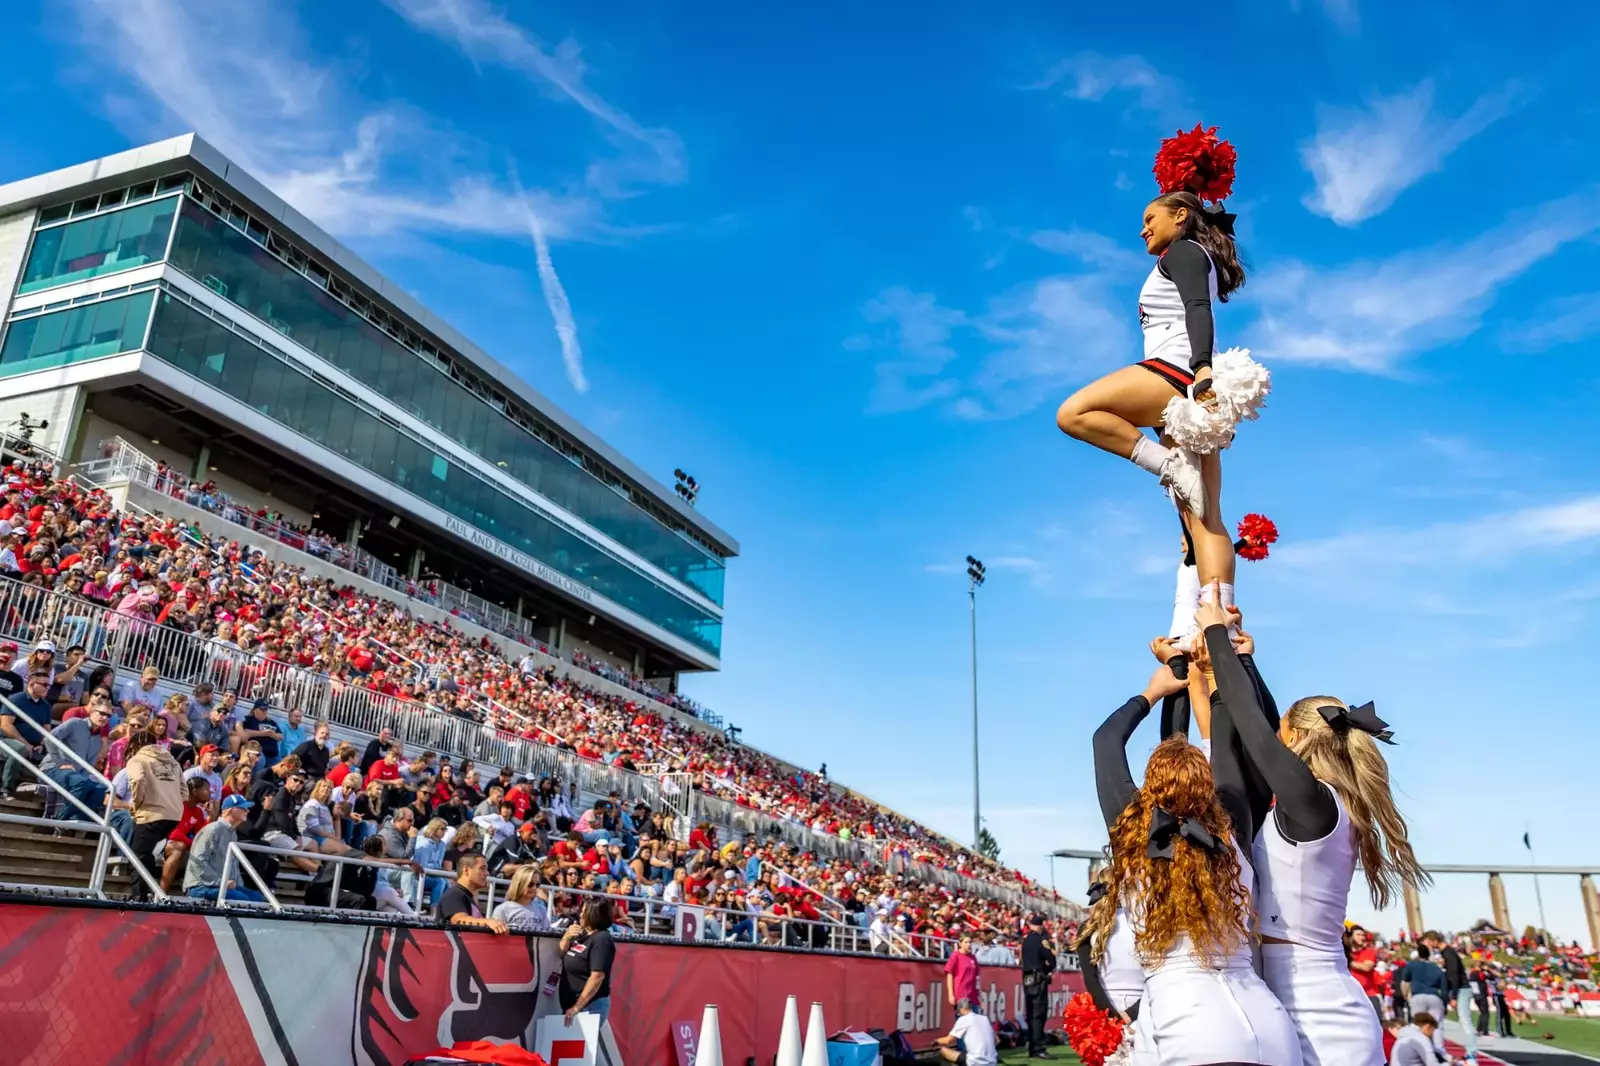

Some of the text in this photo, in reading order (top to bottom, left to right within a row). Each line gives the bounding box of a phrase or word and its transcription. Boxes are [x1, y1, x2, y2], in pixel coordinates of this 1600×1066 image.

[446, 516, 593, 601] PAUL AND PAT KOZEL MEDIA CENTER
[897, 983, 942, 1032] Ball
